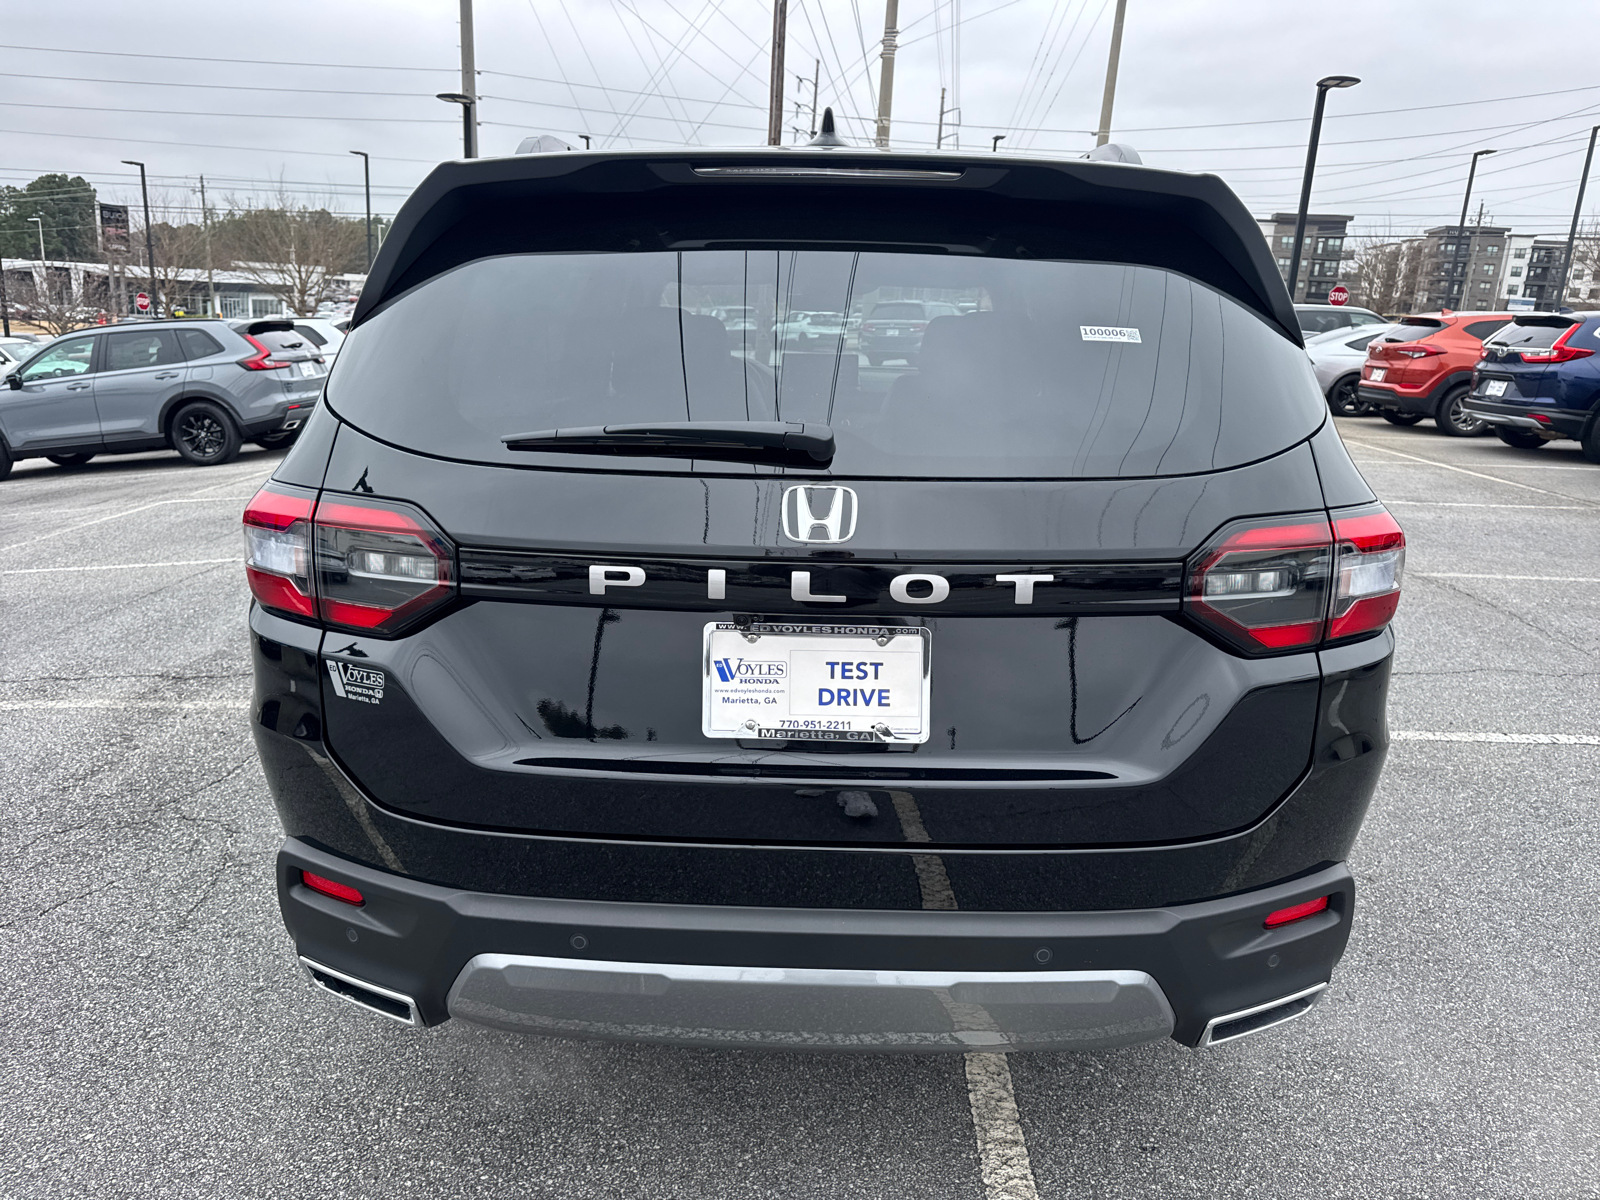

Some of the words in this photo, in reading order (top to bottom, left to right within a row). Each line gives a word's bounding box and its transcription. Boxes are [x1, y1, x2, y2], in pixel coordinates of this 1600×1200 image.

[1330, 291, 1348, 301] STOP
[1082, 328, 1126, 337] 100006
[588, 565, 1055, 604] PILOT
[772, 625, 832, 634] VOYLES
[834, 626, 889, 635] HONDA
[329, 664, 337, 672] ED
[722, 657, 784, 680] VOYLES
[826, 661, 884, 680] TEST
[337, 662, 383, 686] VOYLES
[344, 685, 375, 696] HONDA
[348, 693, 371, 703] Marietta,
[722, 696, 761, 705] Marietta,
[818, 688, 891, 707] DRIVE
[779, 720, 852, 730] 770-951-2211
[760, 729, 840, 740] Marietta,
[846, 731, 872, 741] GA
